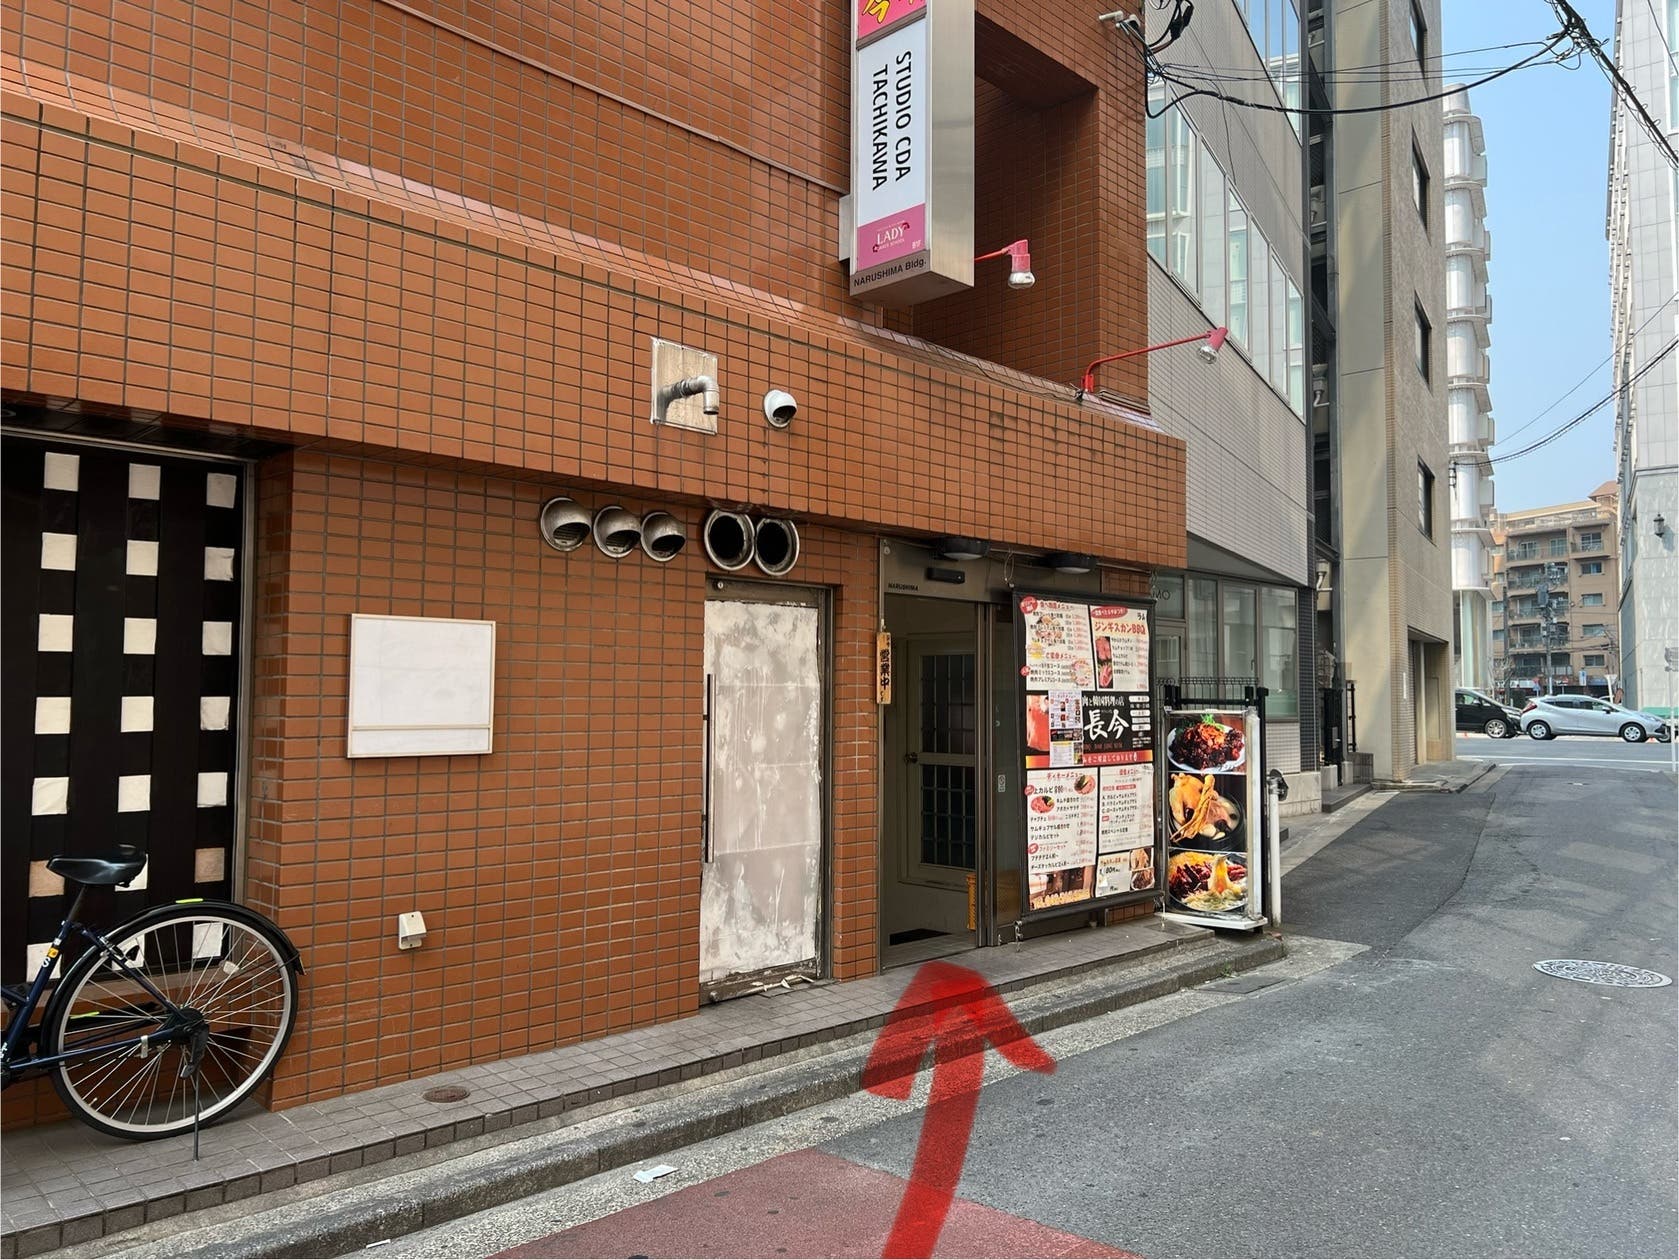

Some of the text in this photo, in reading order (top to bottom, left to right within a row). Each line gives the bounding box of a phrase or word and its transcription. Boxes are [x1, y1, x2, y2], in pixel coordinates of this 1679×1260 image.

[872, 63, 889, 191] TACHIKAWA
[895, 50, 912, 182] STUDIO CDA
[877, 226, 905, 245] LADY
[853, 257, 927, 287] NARUSHIMA Bldg.
[1095, 621, 1147, 635] ジンギスカンBBQ
[1083, 708, 1130, 741] 長今
